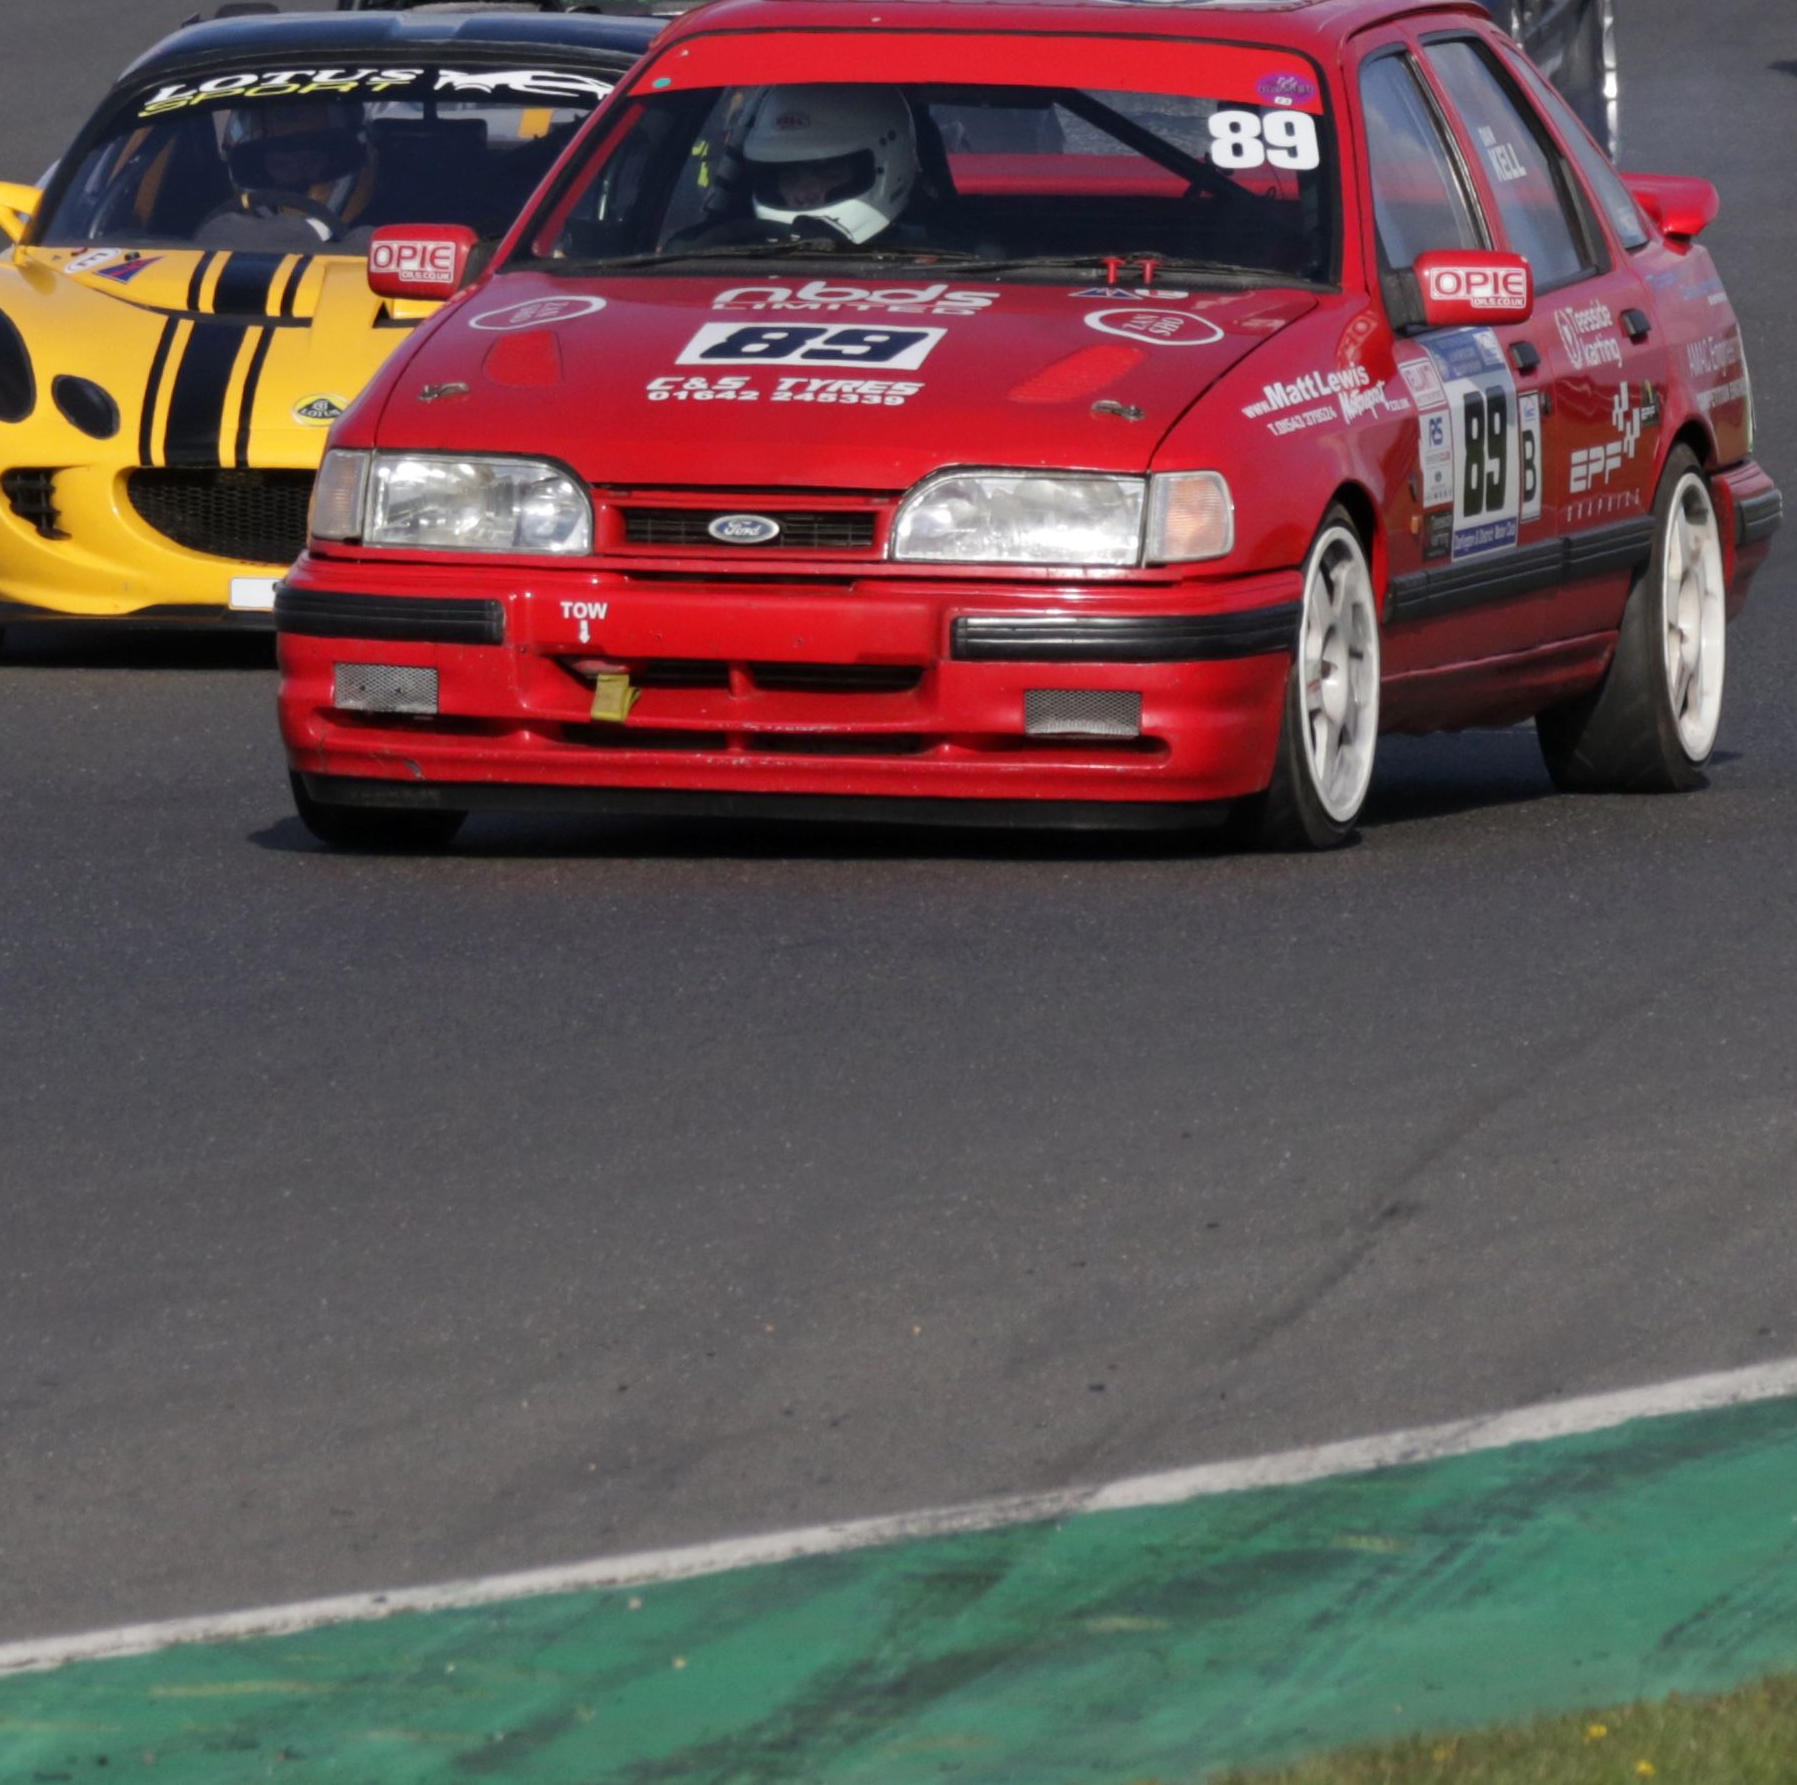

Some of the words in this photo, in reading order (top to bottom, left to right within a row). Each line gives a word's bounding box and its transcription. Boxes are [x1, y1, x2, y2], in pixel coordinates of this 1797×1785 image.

[138, 81, 411, 118] SPORT
[144, 68, 425, 106] LOTUS
[1207, 109, 1321, 171] 89
[1486, 142, 1528, 183] KELL
[372, 244, 452, 270] OPIE
[712, 280, 1001, 308] nbds
[1434, 270, 1524, 296] OPIE
[711, 300, 983, 316] LIMITED
[1473, 297, 1524, 306] OILS.CO.UK
[699, 325, 930, 363] 89
[646, 375, 752, 392] C&S
[776, 377, 925, 397] TYRES
[647, 388, 760, 402] 01642
[770, 390, 905, 406] 245339
[1428, 417, 1444, 448] RS
[1462, 384, 1508, 519] 89
[1521, 428, 1537, 504] B
[723, 519, 763, 537] Ford
[560, 601, 608, 620] TOW
